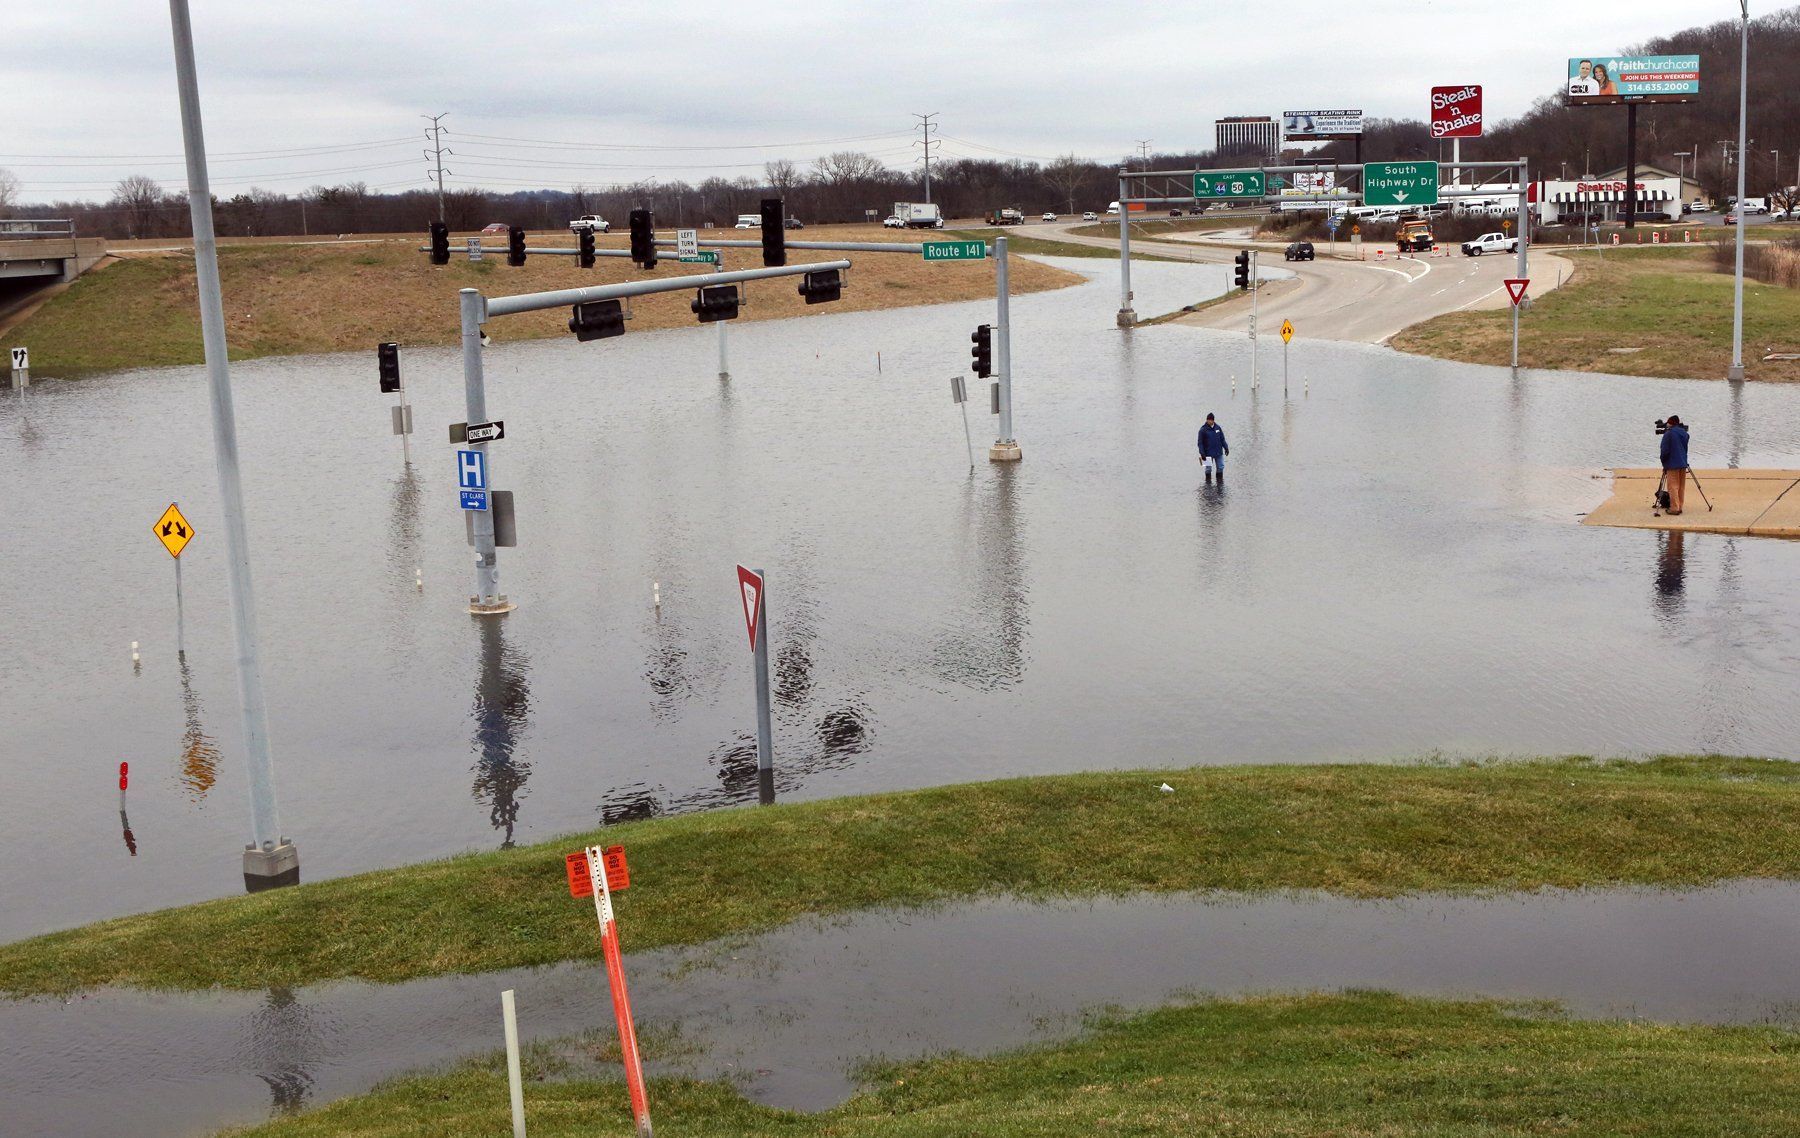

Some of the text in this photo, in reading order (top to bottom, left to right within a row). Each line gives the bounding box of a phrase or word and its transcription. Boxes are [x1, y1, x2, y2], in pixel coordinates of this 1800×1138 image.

[1619, 59, 1698, 71] faithchurch.com
[1627, 82, 1690, 92] 314.635.2000
[1432, 86, 1478, 110] Steak
[1432, 113, 1481, 136] Shake
[1384, 165, 1417, 174] South
[1368, 177, 1433, 189] Highway Dr
[1577, 182, 1605, 193] Steak
[1613, 181, 1646, 192] She
[928, 244, 980, 257] Route 141
[470, 428, 493, 439] ONE WAY
[461, 452, 482, 487] H
